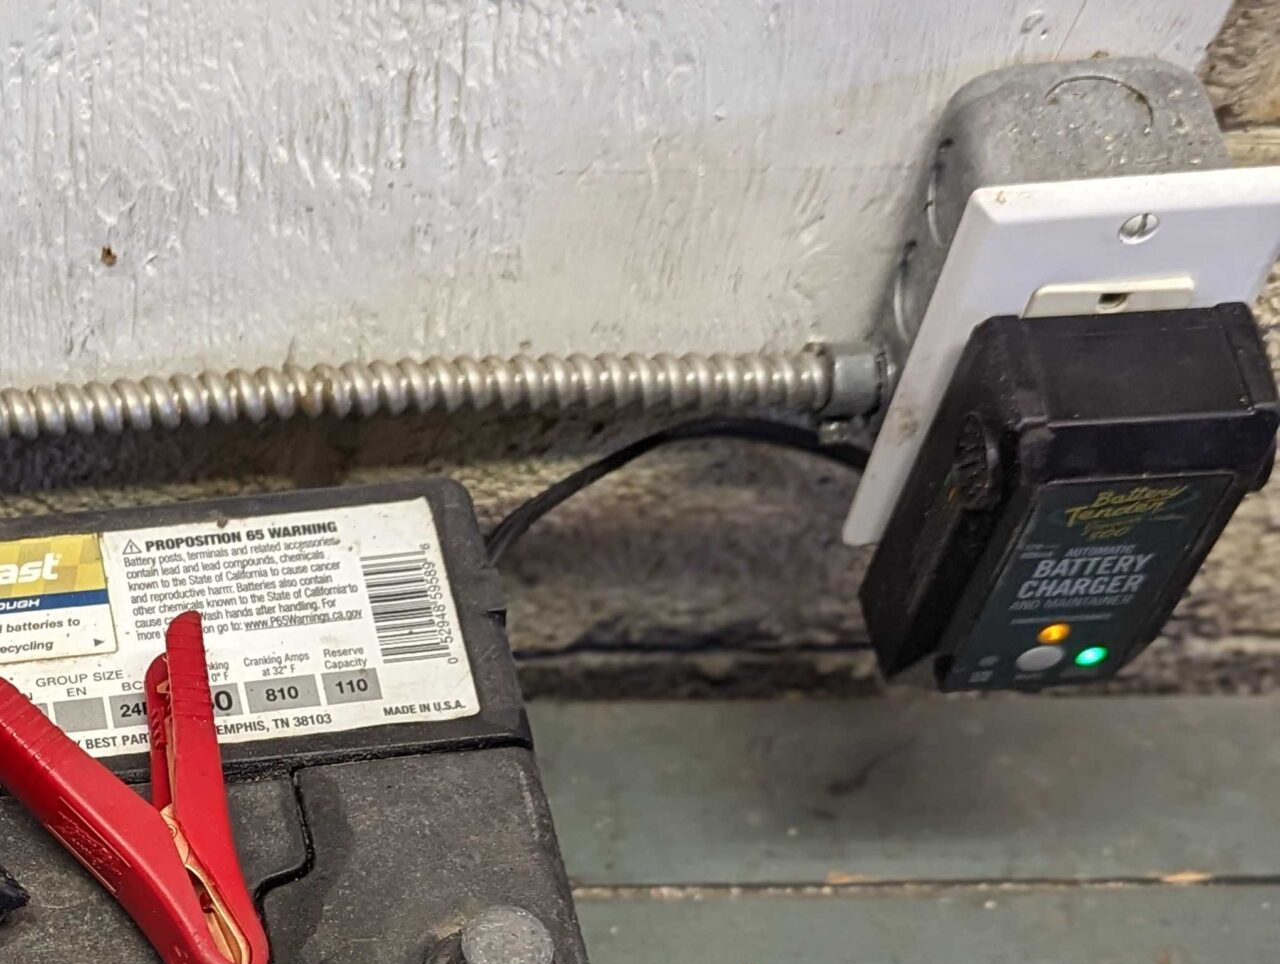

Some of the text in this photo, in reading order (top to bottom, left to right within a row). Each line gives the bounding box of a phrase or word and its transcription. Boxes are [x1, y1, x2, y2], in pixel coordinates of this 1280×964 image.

[1094, 484, 1190, 506] Battery
[145, 521, 337, 552] PROPOSITION 65 WARNING
[123, 556, 156, 569] Battery
[159, 552, 186, 565] posts,
[186, 547, 229, 560] terminals
[231, 545, 247, 555] and
[250, 541, 281, 554] related
[1065, 544, 1136, 558] AUTOMATIC
[126, 550, 325, 579] contain lead and lead compounds, chemicals
[1032, 553, 1155, 579] BATTERY
[128, 562, 341, 591] known to the State of California to cause cancer
[130, 594, 147, 604] and
[150, 587, 205, 603] reproductive
[236, 579, 276, 593] Batteries
[278, 578, 297, 589] also
[300, 574, 333, 586] contain
[1017, 575, 1148, 600] CHARGER
[133, 583, 358, 616] other chemicals known to the State of California to
[135, 617, 162, 629] cause
[225, 607, 254, 619] hands
[256, 603, 276, 615] after
[278, 601, 320, 613] handling.
[322, 598, 336, 608] For
[6, 619, 64, 633] batteries
[68, 617, 81, 628] to
[217, 623, 229, 634] go
[230, 621, 243, 631] to:
[243, 651, 310, 668] Cranking Amps
[323, 647, 364, 658] Reserve
[262, 668, 273, 677] at
[290, 665, 296, 674] F
[324, 657, 368, 670] Capacity
[35, 670, 124, 688] GROUP SIZE
[223, 671, 229, 680] F
[66, 687, 87, 698] EN
[121, 681, 143, 691] BC
[265, 685, 299, 702] 810
[335, 678, 369, 694] 110
[383, 700, 467, 717] MADE IN U.S.A.
[85, 736, 118, 749] BEST
[216, 720, 270, 736] EMPHIS,
[272, 717, 292, 729] TN
[293, 714, 332, 727] 38103
